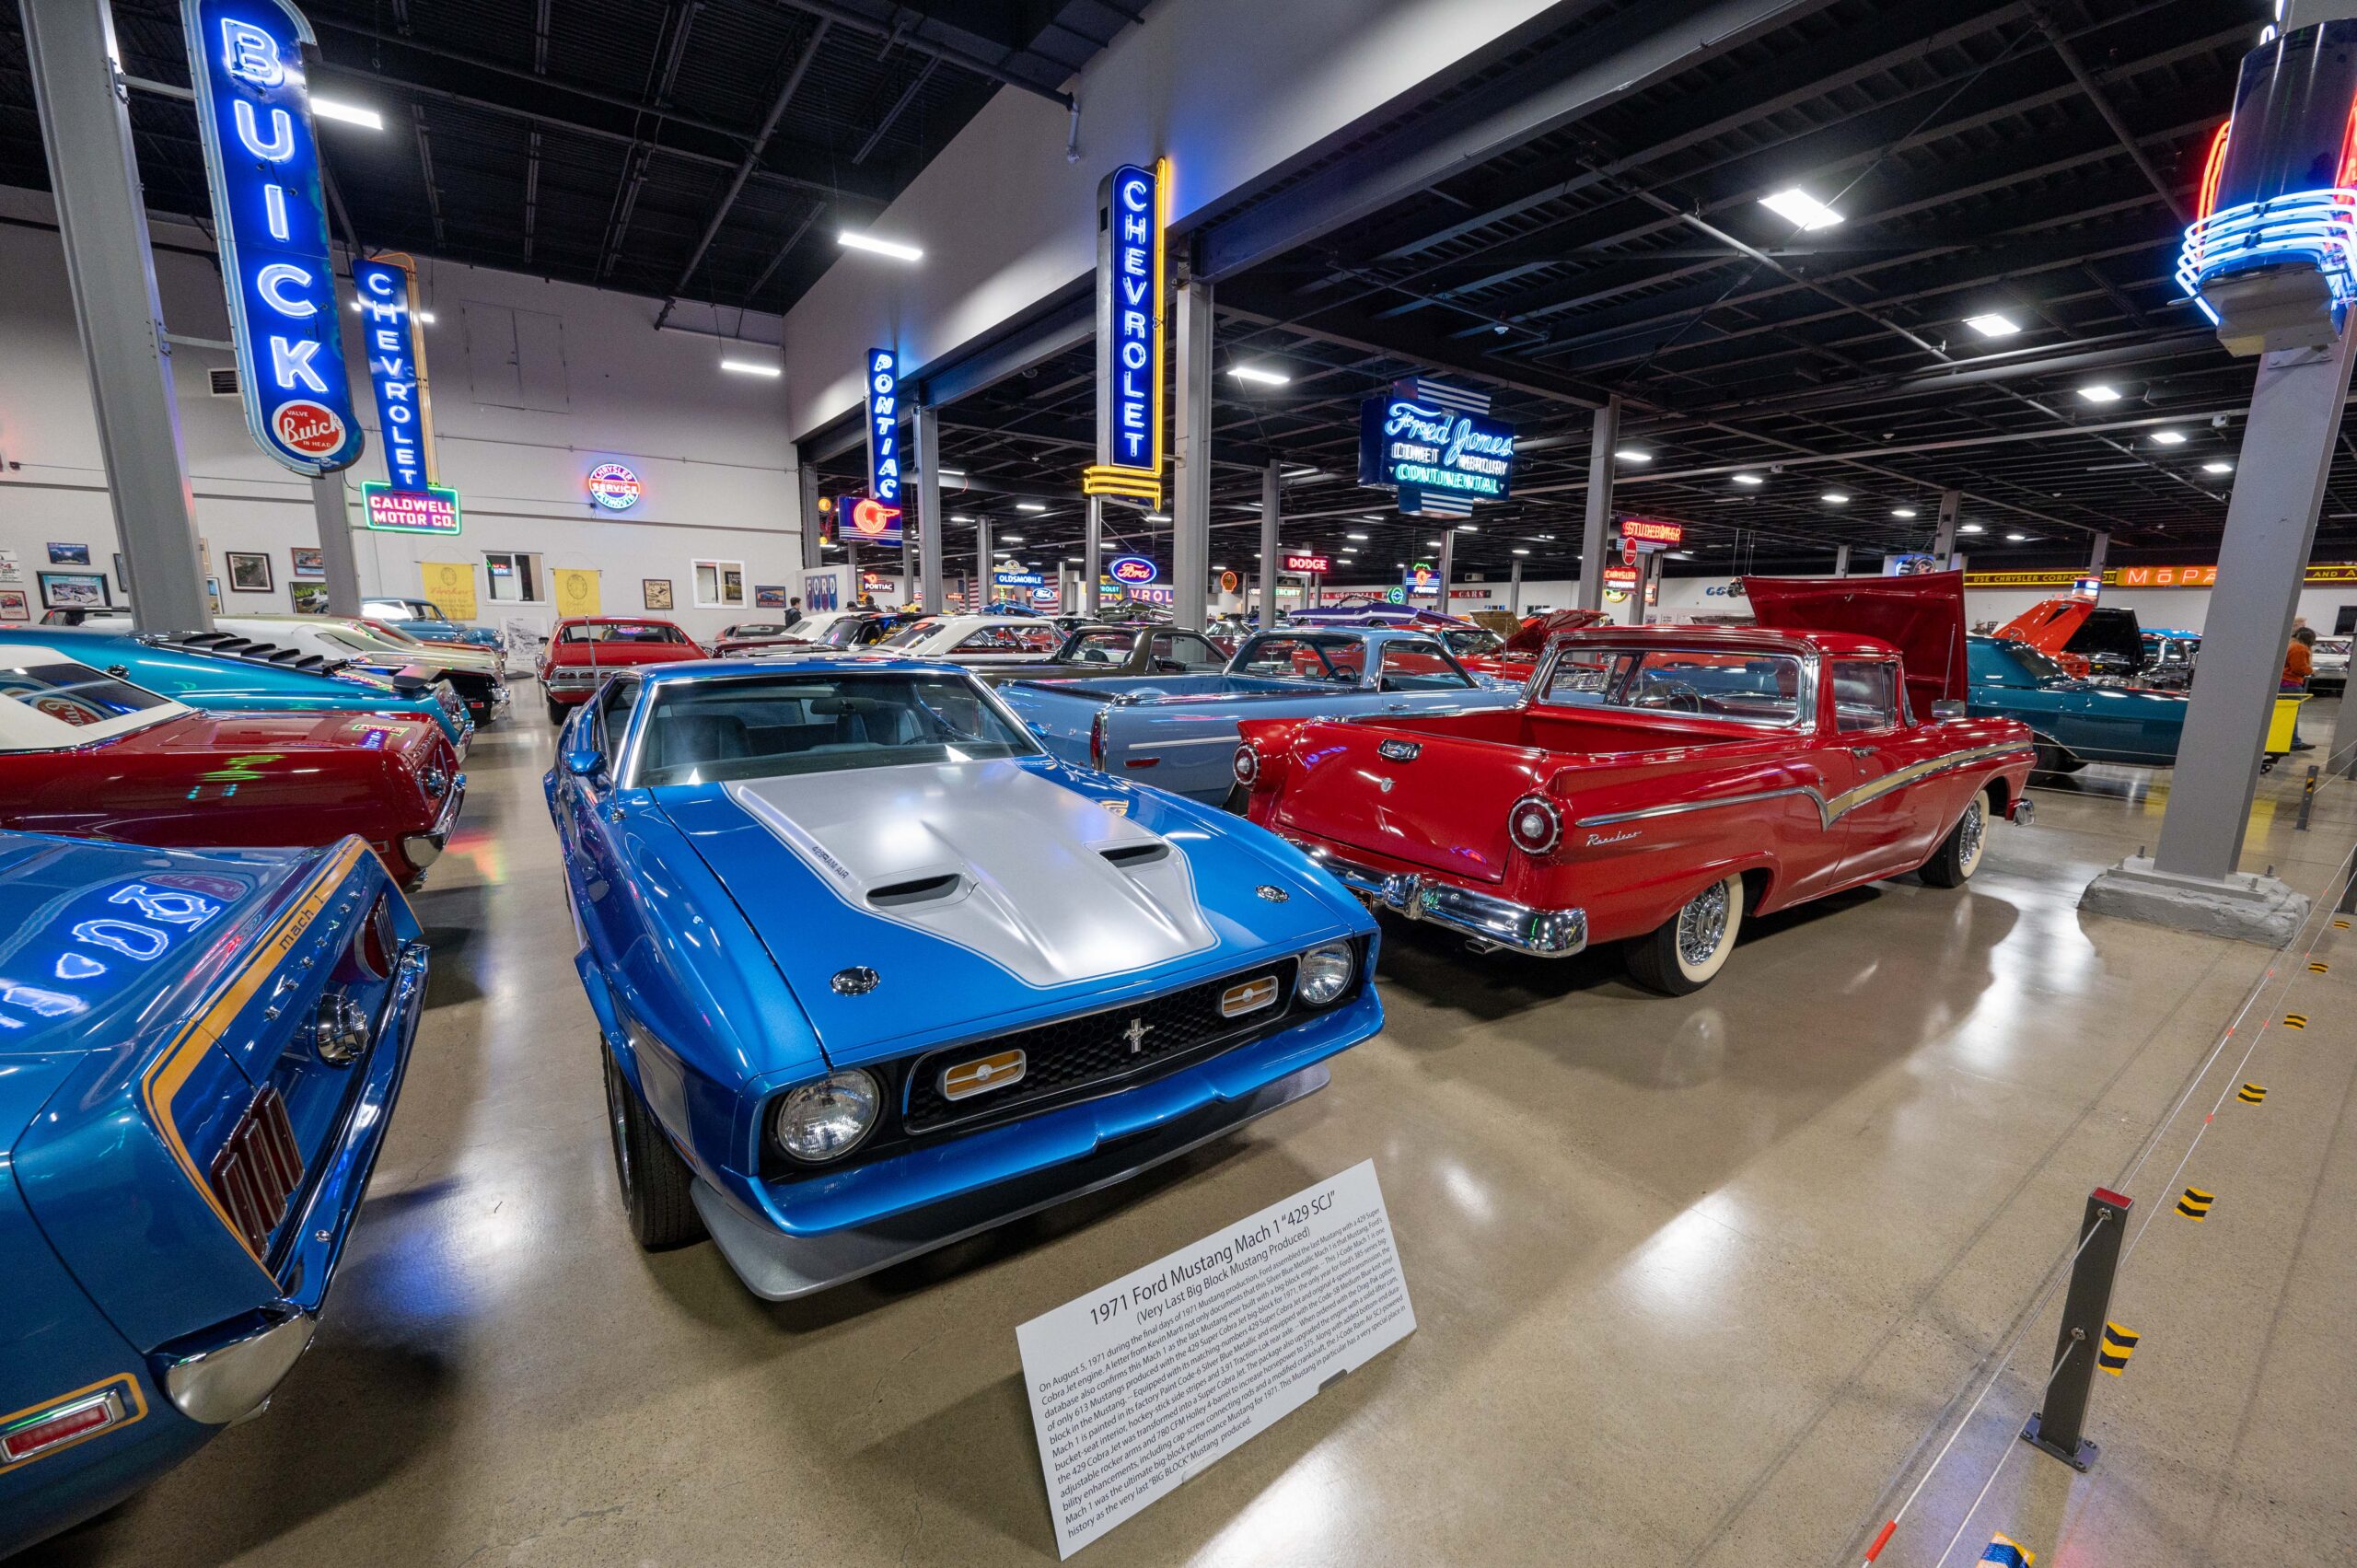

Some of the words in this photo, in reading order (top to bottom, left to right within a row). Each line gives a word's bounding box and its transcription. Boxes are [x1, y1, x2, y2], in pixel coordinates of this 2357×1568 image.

[221, 17, 329, 393] BUICK
[1122, 180, 1147, 458] CHEVROLET
[368, 273, 417, 485] CHEVROLET
[284, 412, 343, 445] Buick
[287, 410, 308, 418] VALVE
[875, 354, 897, 498] PONTIAC
[1385, 403, 1452, 445] Fred
[1444, 418, 1513, 466] Jones
[594, 465, 633, 481] CHRYSLER
[1391, 442, 1440, 463] COMET
[1456, 454, 1508, 476] MERCURY
[1396, 463, 1499, 494] CONTINENTAL
[370, 496, 456, 514] CALDWELL
[592, 482, 638, 494] SERVICE
[596, 492, 635, 507] PLYMOUTH
[373, 510, 427, 526] MOTOR
[432, 514, 457, 528] CO.
[1622, 521, 1681, 541] STUDEBAKER
[999, 575, 1041, 584] OLDSMOBILE
[1117, 563, 1150, 578] Ford
[1289, 557, 1327, 570] DODGE
[1604, 570, 1636, 580] CHRYSLER
[1973, 575, 1990, 583] USE
[807, 577, 836, 596] FORD
[834, 866, 849, 879] AIR
[279, 909, 314, 950] mach
[1090, 1294, 1127, 1325] 1971
[1132, 1272, 1167, 1305] Ford
[1170, 1246, 1233, 1286] Mustang
[1234, 1225, 1271, 1254] Mach
[1272, 1219, 1280, 1234] 1
[1281, 1204, 1309, 1225] “429
[1310, 1190, 1334, 1214] SCJ”
[1136, 1303, 1163, 1325] (Very
[1164, 1291, 1185, 1309] Last
[1186, 1283, 1202, 1298] Big
[1202, 1268, 1229, 1289] Block
[1229, 1249, 1268, 1275] Mustang
[1268, 1225, 1310, 1255] Produced)
[1041, 1388, 1065, 1405] Cobra
[1065, 1381, 1077, 1394] Jet
[1110, 1353, 1130, 1368] letter
[1130, 1345, 1147, 1358] from
[1146, 1334, 1167, 1349] Kevin
[1166, 1324, 1184, 1339] Marti
[1052, 1366, 1079, 1387] August
[1087, 1352, 1105, 1366] 1971
[1106, 1341, 1131, 1357] during
[1130, 1334, 1143, 1344] the
[1143, 1324, 1158, 1338] final
[1158, 1318, 1174, 1330] days
[1044, 1395, 1079, 1418] database
[1080, 1387, 1096, 1400] also
[1096, 1368, 1128, 1390] confirms
[1128, 1361, 1142, 1373] this
[1142, 1350, 1162, 1365] Mach
[1176, 1336, 1188, 1347] the
[1056, 1411, 1074, 1426] only
[1074, 1402, 1089, 1417] 613
[1089, 1384, 1125, 1408] Mustangs
[1125, 1363, 1158, 1390] produced
[1159, 1355, 1175, 1369] with
[1175, 1350, 1187, 1361] the
[1170, 1390, 1185, 1404] side
[1049, 1426, 1072, 1445] block
[1079, 1416, 1092, 1428] the
[1132, 1372, 1167, 1398] Equipped
[1166, 1365, 1182, 1378] with
[1181, 1361, 1190, 1370] its
[1051, 1440, 1074, 1458] Mach
[1087, 1414, 1117, 1440] painted
[1125, 1406, 1134, 1416] its
[1134, 1392, 1159, 1411] factory
[1159, 1381, 1178, 1396] Paint
[1057, 1472, 1071, 1484] the
[1072, 1461, 1086, 1475] 429
[1086, 1449, 1109, 1467] Cobra
[1110, 1441, 1121, 1454] Jet
[1121, 1433, 1136, 1446] was
[1136, 1406, 1178, 1437] transformed
[1178, 1400, 1192, 1412] into
[1060, 1469, 1099, 1498] adjustable
[1100, 1455, 1122, 1473] rocker
[1124, 1444, 1142, 1459] arms
[1143, 1433, 1156, 1448] and
[1155, 1425, 1170, 1439] 780
[1169, 1416, 1186, 1431] CFM
[1185, 1405, 1206, 1422] Holley
[1062, 1494, 1082, 1511] bility
[1139, 1439, 1172, 1464] including
[1065, 1505, 1087, 1525] Mach
[1094, 1493, 1109, 1506] was
[1109, 1484, 1122, 1497] the
[1123, 1465, 1153, 1489] ultimate
[1067, 1516, 1095, 1538] history
[1105, 1502, 1118, 1515] the
[1118, 1491, 1135, 1505] very
[1135, 1481, 1149, 1495] last
[1190, 1437, 1219, 1460] Mustang
